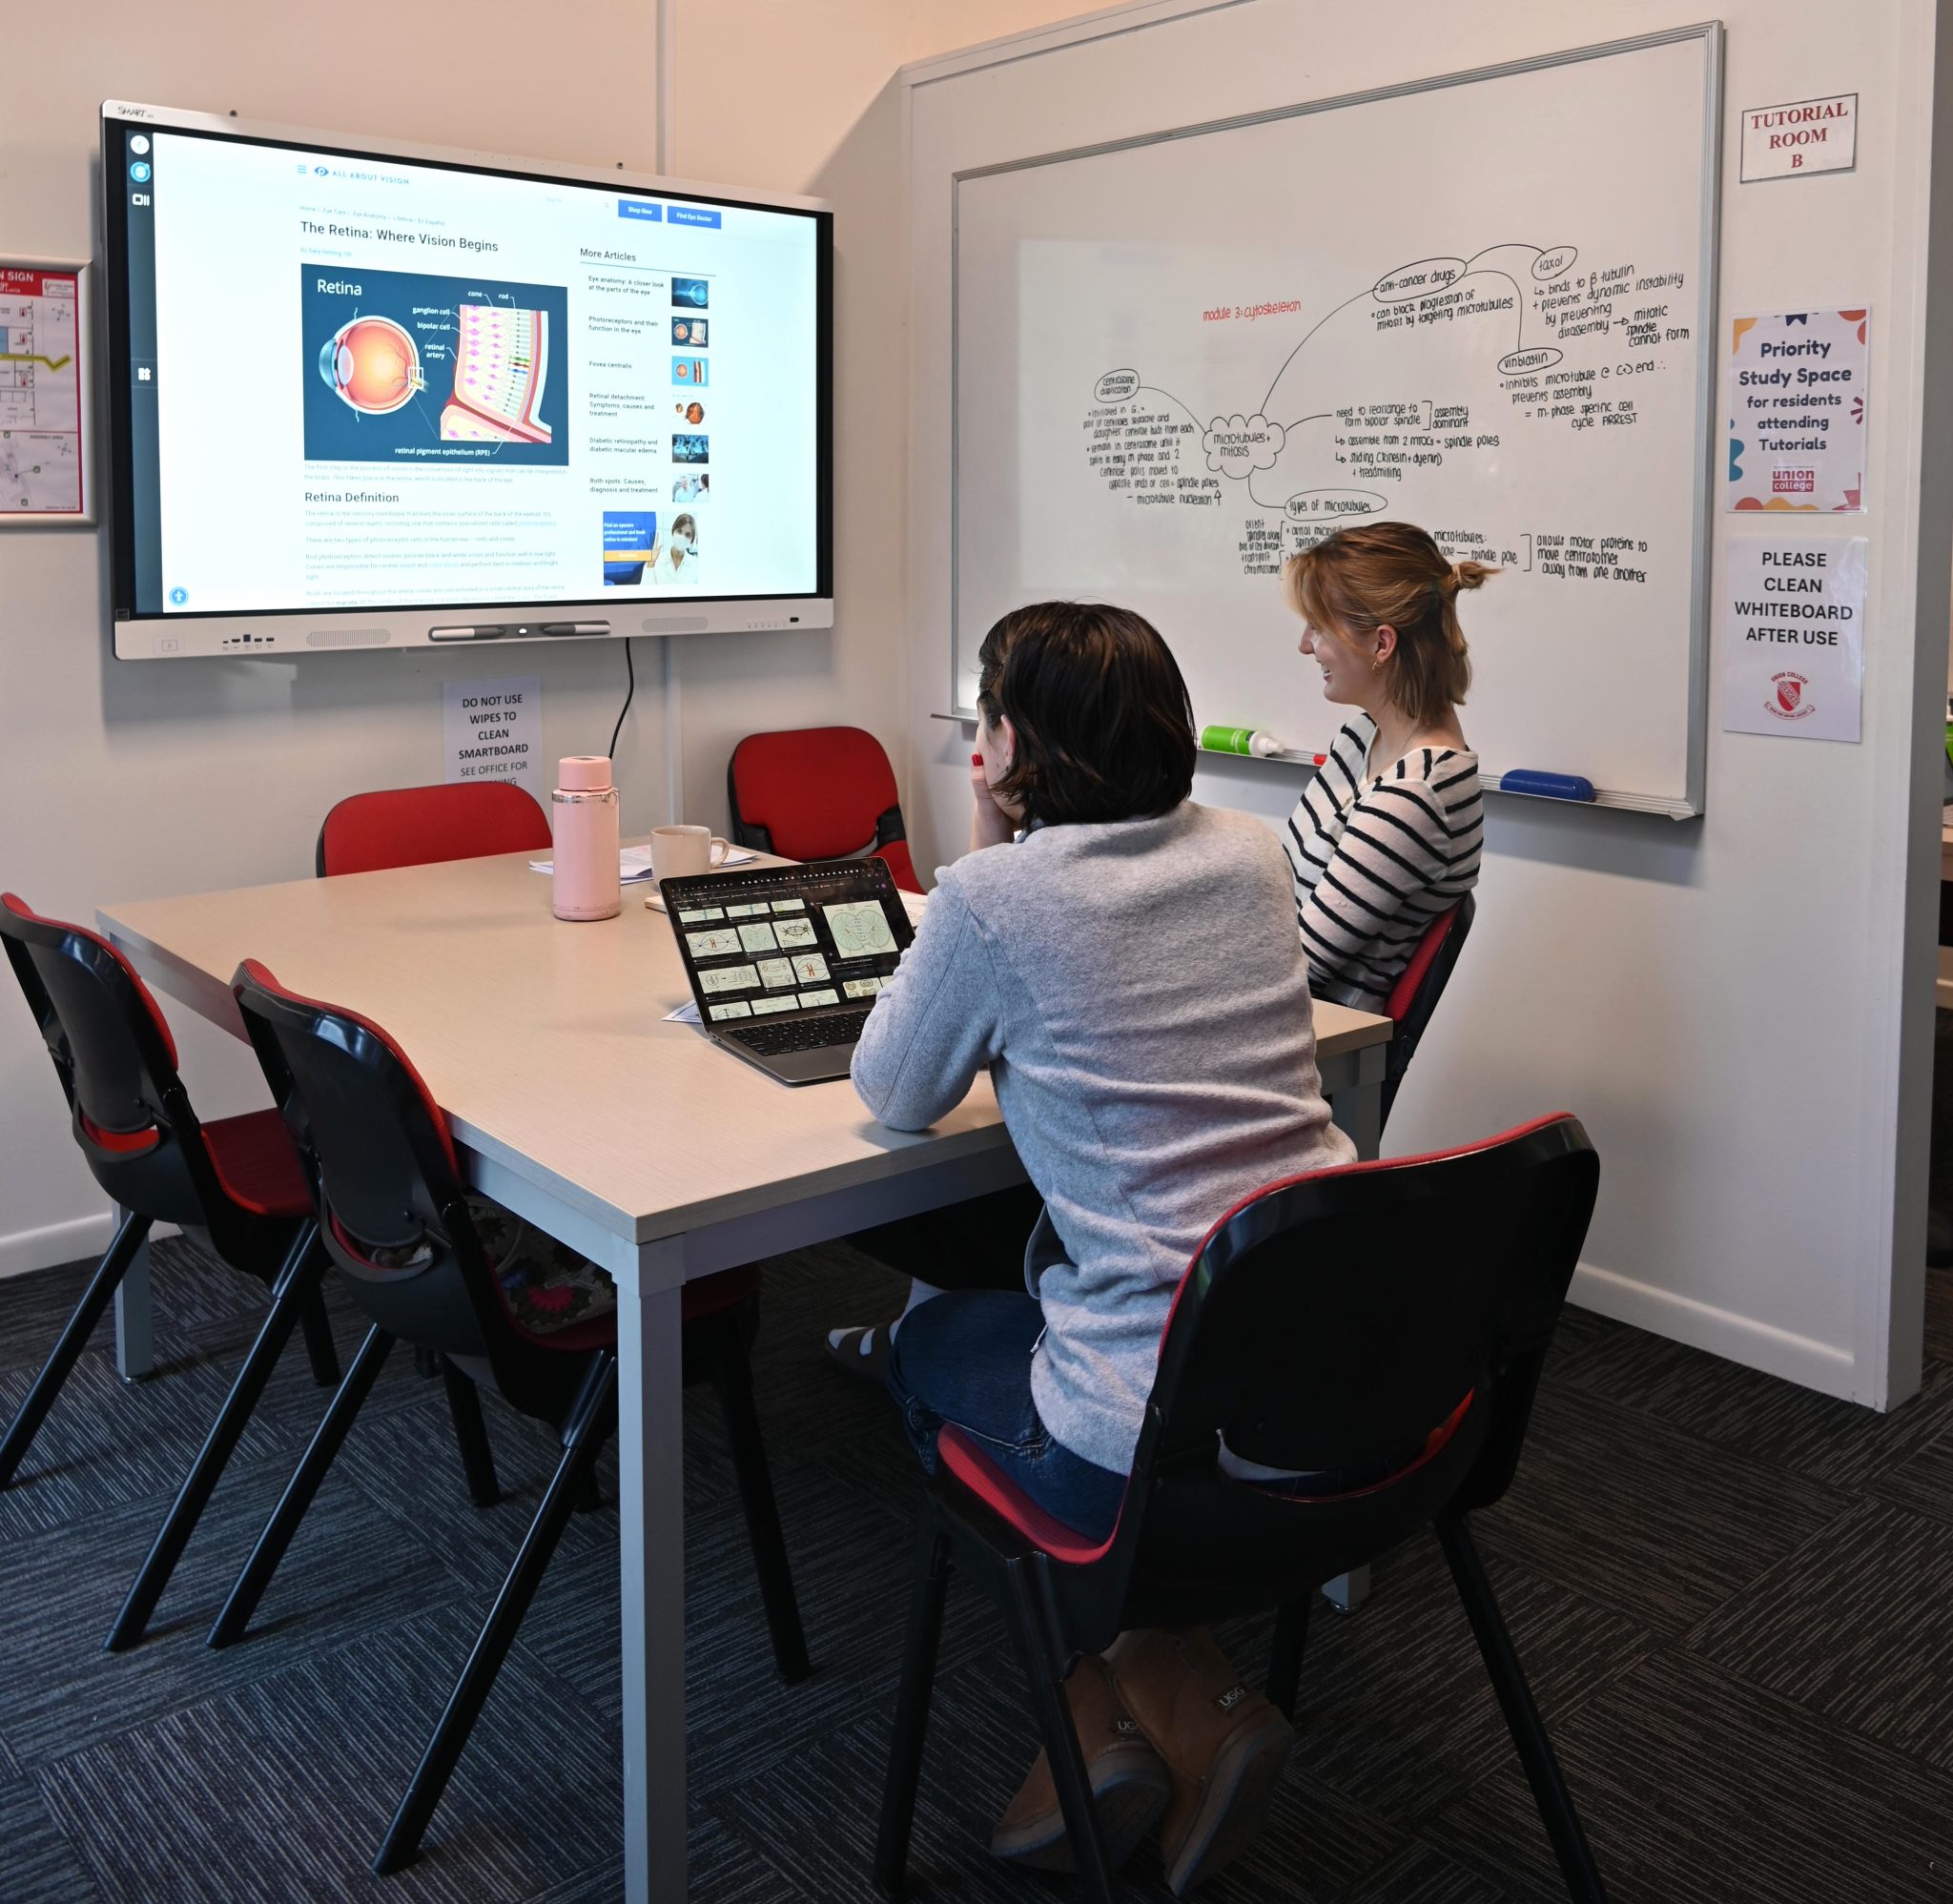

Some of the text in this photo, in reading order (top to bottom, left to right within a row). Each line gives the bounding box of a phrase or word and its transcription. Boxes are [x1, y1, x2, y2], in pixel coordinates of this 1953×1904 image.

[117, 106, 146, 117] SMART
[1752, 103, 1848, 129] TUTORIAL
[1769, 128, 1828, 150] ROOM
[1791, 154, 1803, 168] B
[350, 173, 377, 181] ABOUT
[380, 175, 409, 185] VISION
[300, 221, 499, 253] The Retina: Where Vision Begins
[580, 248, 637, 261] More Articles
[1539, 256, 1563, 272] taxol
[8, 272, 34, 282] SIGN
[1379, 269, 1456, 293] anti-cancer drugs
[1549, 264, 1634, 295] binds to tubulin
[317, 278, 362, 297] Retina
[1542, 273, 1684, 313] prevents dynamic instability
[412, 307, 439, 316] ganglion
[1376, 289, 1475, 319] can block progression of
[1203, 307, 1231, 321] module
[1377, 297, 1513, 331] mitosis by targeting microtubules
[1545, 303, 1612, 328] by preventing
[1634, 305, 1668, 321] mitotic
[417, 321, 439, 330] bipolar
[1558, 319, 1610, 338] disassembly
[1626, 322, 1657, 337] spindle
[1629, 327, 1690, 347] cannot form
[426, 352, 445, 360] artery
[1760, 339, 1831, 358] Priority
[1504, 352, 1548, 369] vinblastin
[1102, 376, 1136, 387] centrosome
[1506, 360, 1654, 390] inhibits microtubule end
[1738, 367, 1852, 388] Study Space
[1100, 385, 1131, 396] duplication
[1512, 385, 1592, 404] prevents assembly
[1580, 401, 1613, 416] specific
[1618, 400, 1634, 412] cell
[1747, 393, 1841, 408] for residents
[1336, 403, 1418, 418] need to rearrange to
[1434, 406, 1469, 418] assembly
[1345, 415, 1421, 427] form bipolar spindle
[1432, 417, 1469, 429] dominant
[1571, 413, 1637, 429] cycle ARREST
[1758, 416, 1829, 431] attending
[1213, 432, 1265, 445] microtubules
[1347, 435, 1499, 449] assemble from 2 spindle poles
[1758, 438, 1827, 451] Tutorials
[416, 447, 441, 457] pigment
[442, 448, 474, 457] epithelium
[1220, 445, 1249, 458] mitosis
[1349, 452, 1374, 466] sliding
[1359, 467, 1401, 481] treadmilling
[1772, 470, 1815, 480] union
[1177, 477, 1219, 491] spindle poles
[1774, 481, 1812, 491] college
[304, 492, 400, 502] Retina Definition
[1137, 494, 1175, 504] microtubule
[1289, 500, 1371, 516] types of microtubules
[1537, 535, 1648, 554] allows motor proteins to
[1242, 551, 1270, 563] transport
[1471, 549, 1518, 566] spindle pole
[1537, 548, 1617, 565] move centrosomes
[1762, 552, 1827, 567] PLEASE
[1542, 563, 1647, 583] away from one another
[1764, 577, 1822, 593] CLEAN
[1735, 601, 1853, 621] WHITEBOARD
[1746, 627, 1839, 645] AFTER USE
[1771, 671, 1808, 685] UNION COLLEGE
[463, 694, 523, 708] DO NOT USE
[469, 711, 516, 725] WIPES TO
[478, 729, 509, 741] CLEAN
[459, 744, 528, 759] SMARTBOARD
[461, 762, 527, 777] SEE OFFICE FOR
[1219, 1686, 1245, 1707] UGG
[1118, 1721, 1138, 1730] UG
